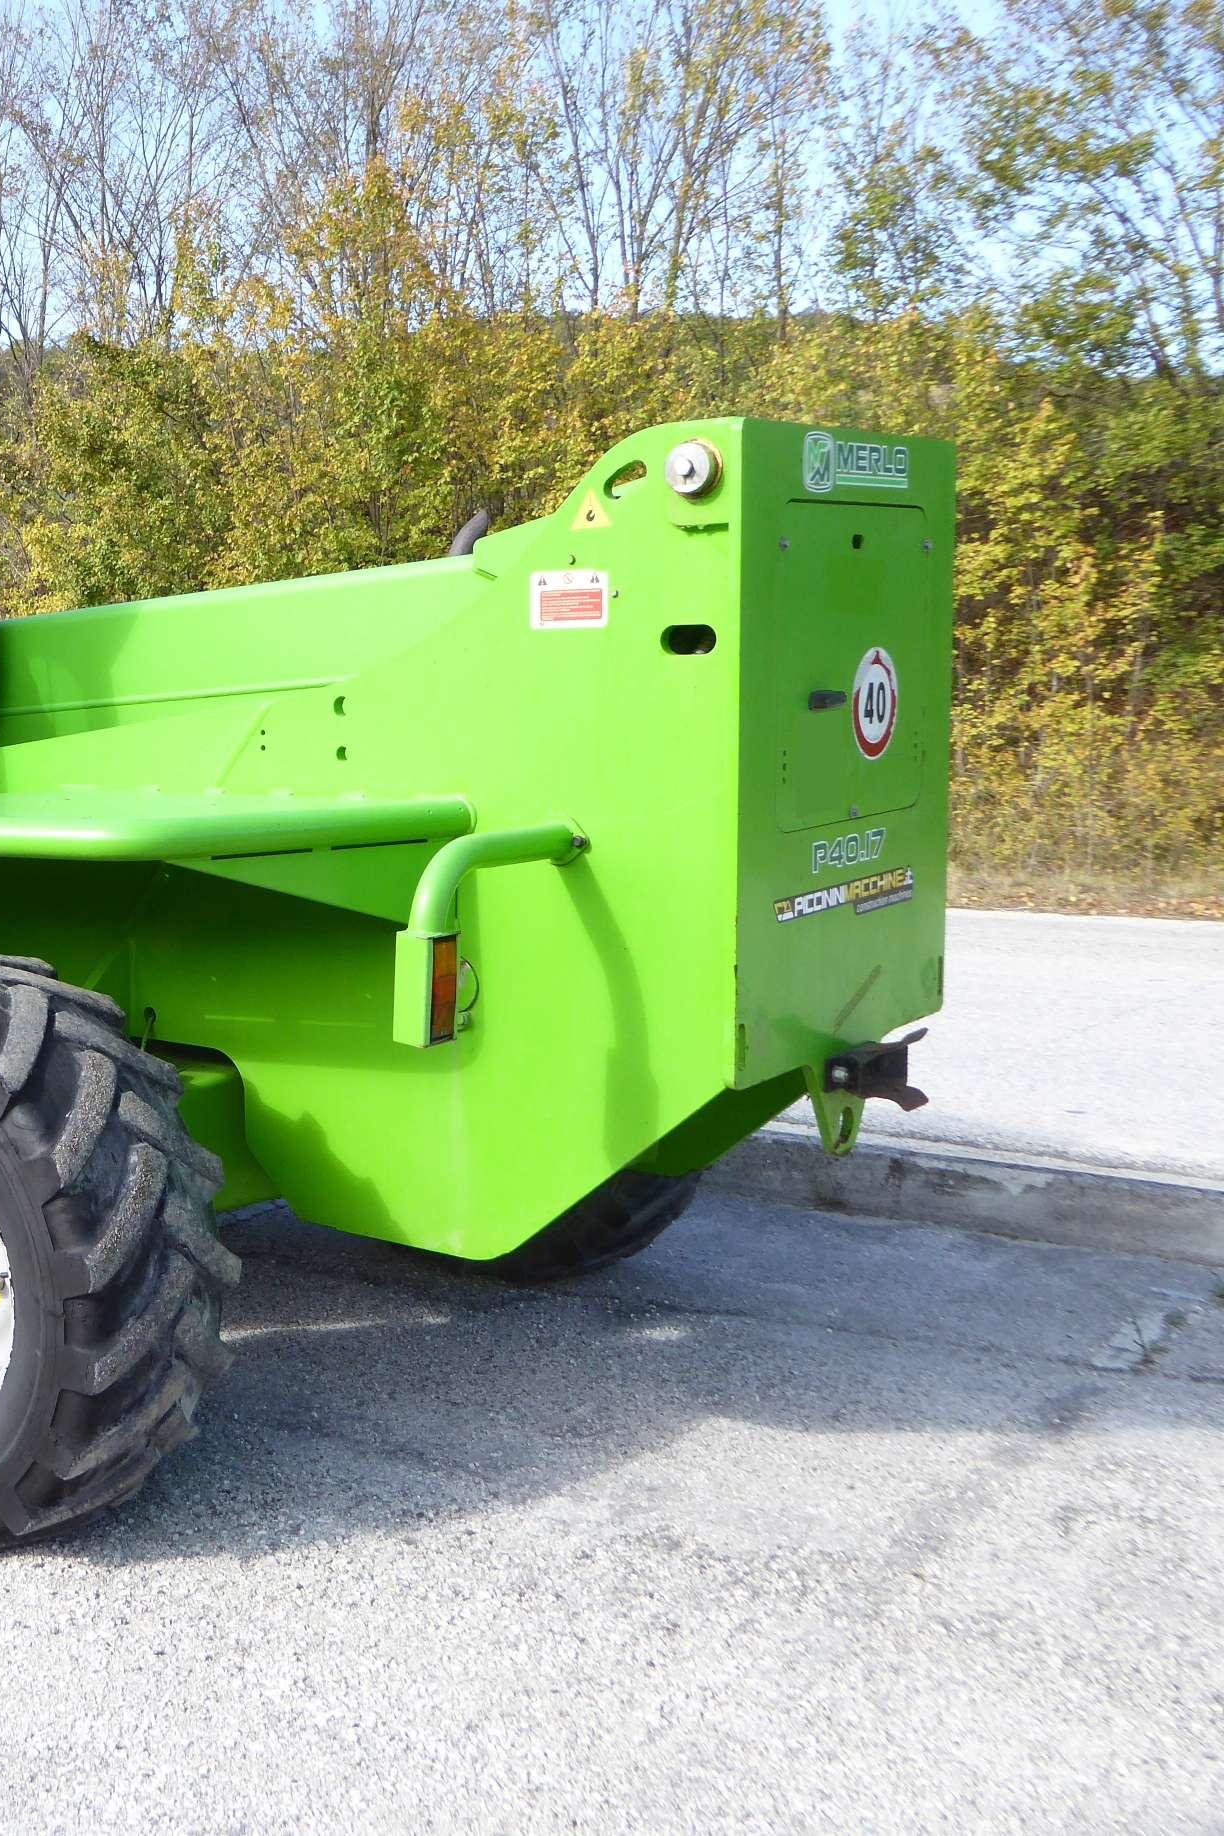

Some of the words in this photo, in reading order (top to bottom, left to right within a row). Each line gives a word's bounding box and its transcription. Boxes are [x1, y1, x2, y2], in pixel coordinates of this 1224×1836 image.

[836, 441, 908, 476] MERLO
[864, 682, 886, 724] 40
[812, 828, 886, 874] P40.17
